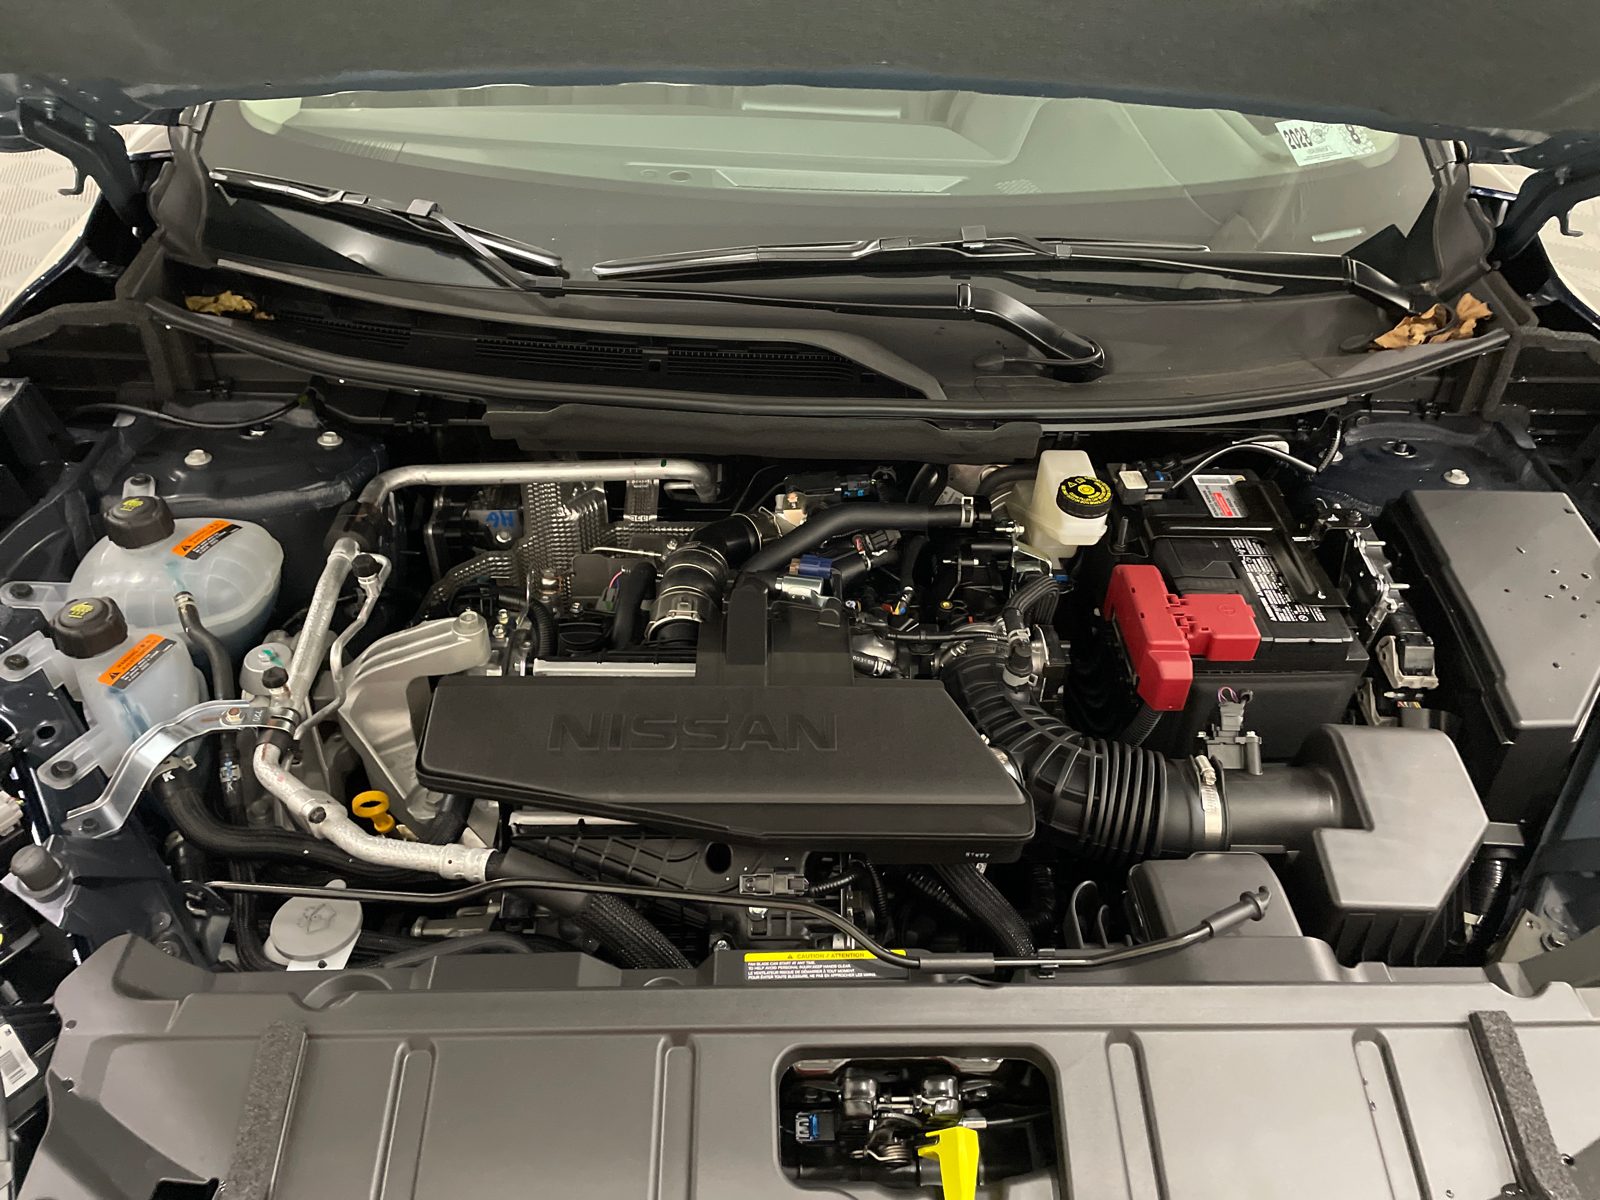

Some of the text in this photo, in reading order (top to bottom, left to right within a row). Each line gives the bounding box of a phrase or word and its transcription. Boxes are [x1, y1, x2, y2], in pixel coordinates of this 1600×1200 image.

[1282, 126, 1313, 150] 2028
[1345, 124, 1361, 144] 8
[547, 713, 837, 751] NISSAN
